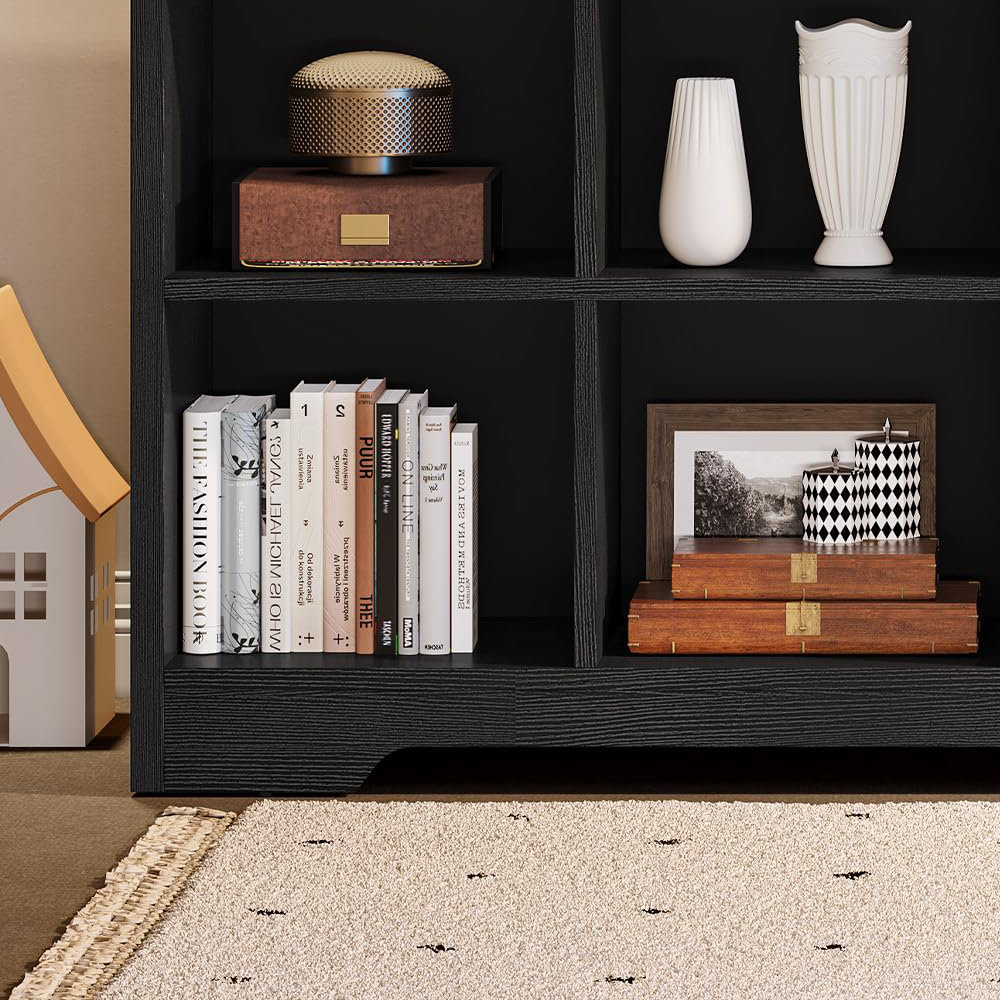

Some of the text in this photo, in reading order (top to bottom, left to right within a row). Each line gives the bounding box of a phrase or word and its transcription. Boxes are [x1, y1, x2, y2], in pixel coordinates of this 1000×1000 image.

[300, 403, 308, 417] 1
[192, 421, 208, 468] THE
[381, 413, 393, 447] EDWARD
[297, 447, 305, 490] ustawienia
[306, 454, 314, 484] Zmiana
[359, 436, 374, 479] PUUR
[381, 448, 393, 479] HOPPER
[402, 459, 414, 485] ON
[192, 475, 208, 574] FASHION
[402, 494, 414, 533] LINE
[297, 549, 306, 606] do konstrukcji
[304, 552, 314, 603] Od dekoracji
[359, 594, 373, 629] THEE
[402, 618, 413, 648] MoMA
